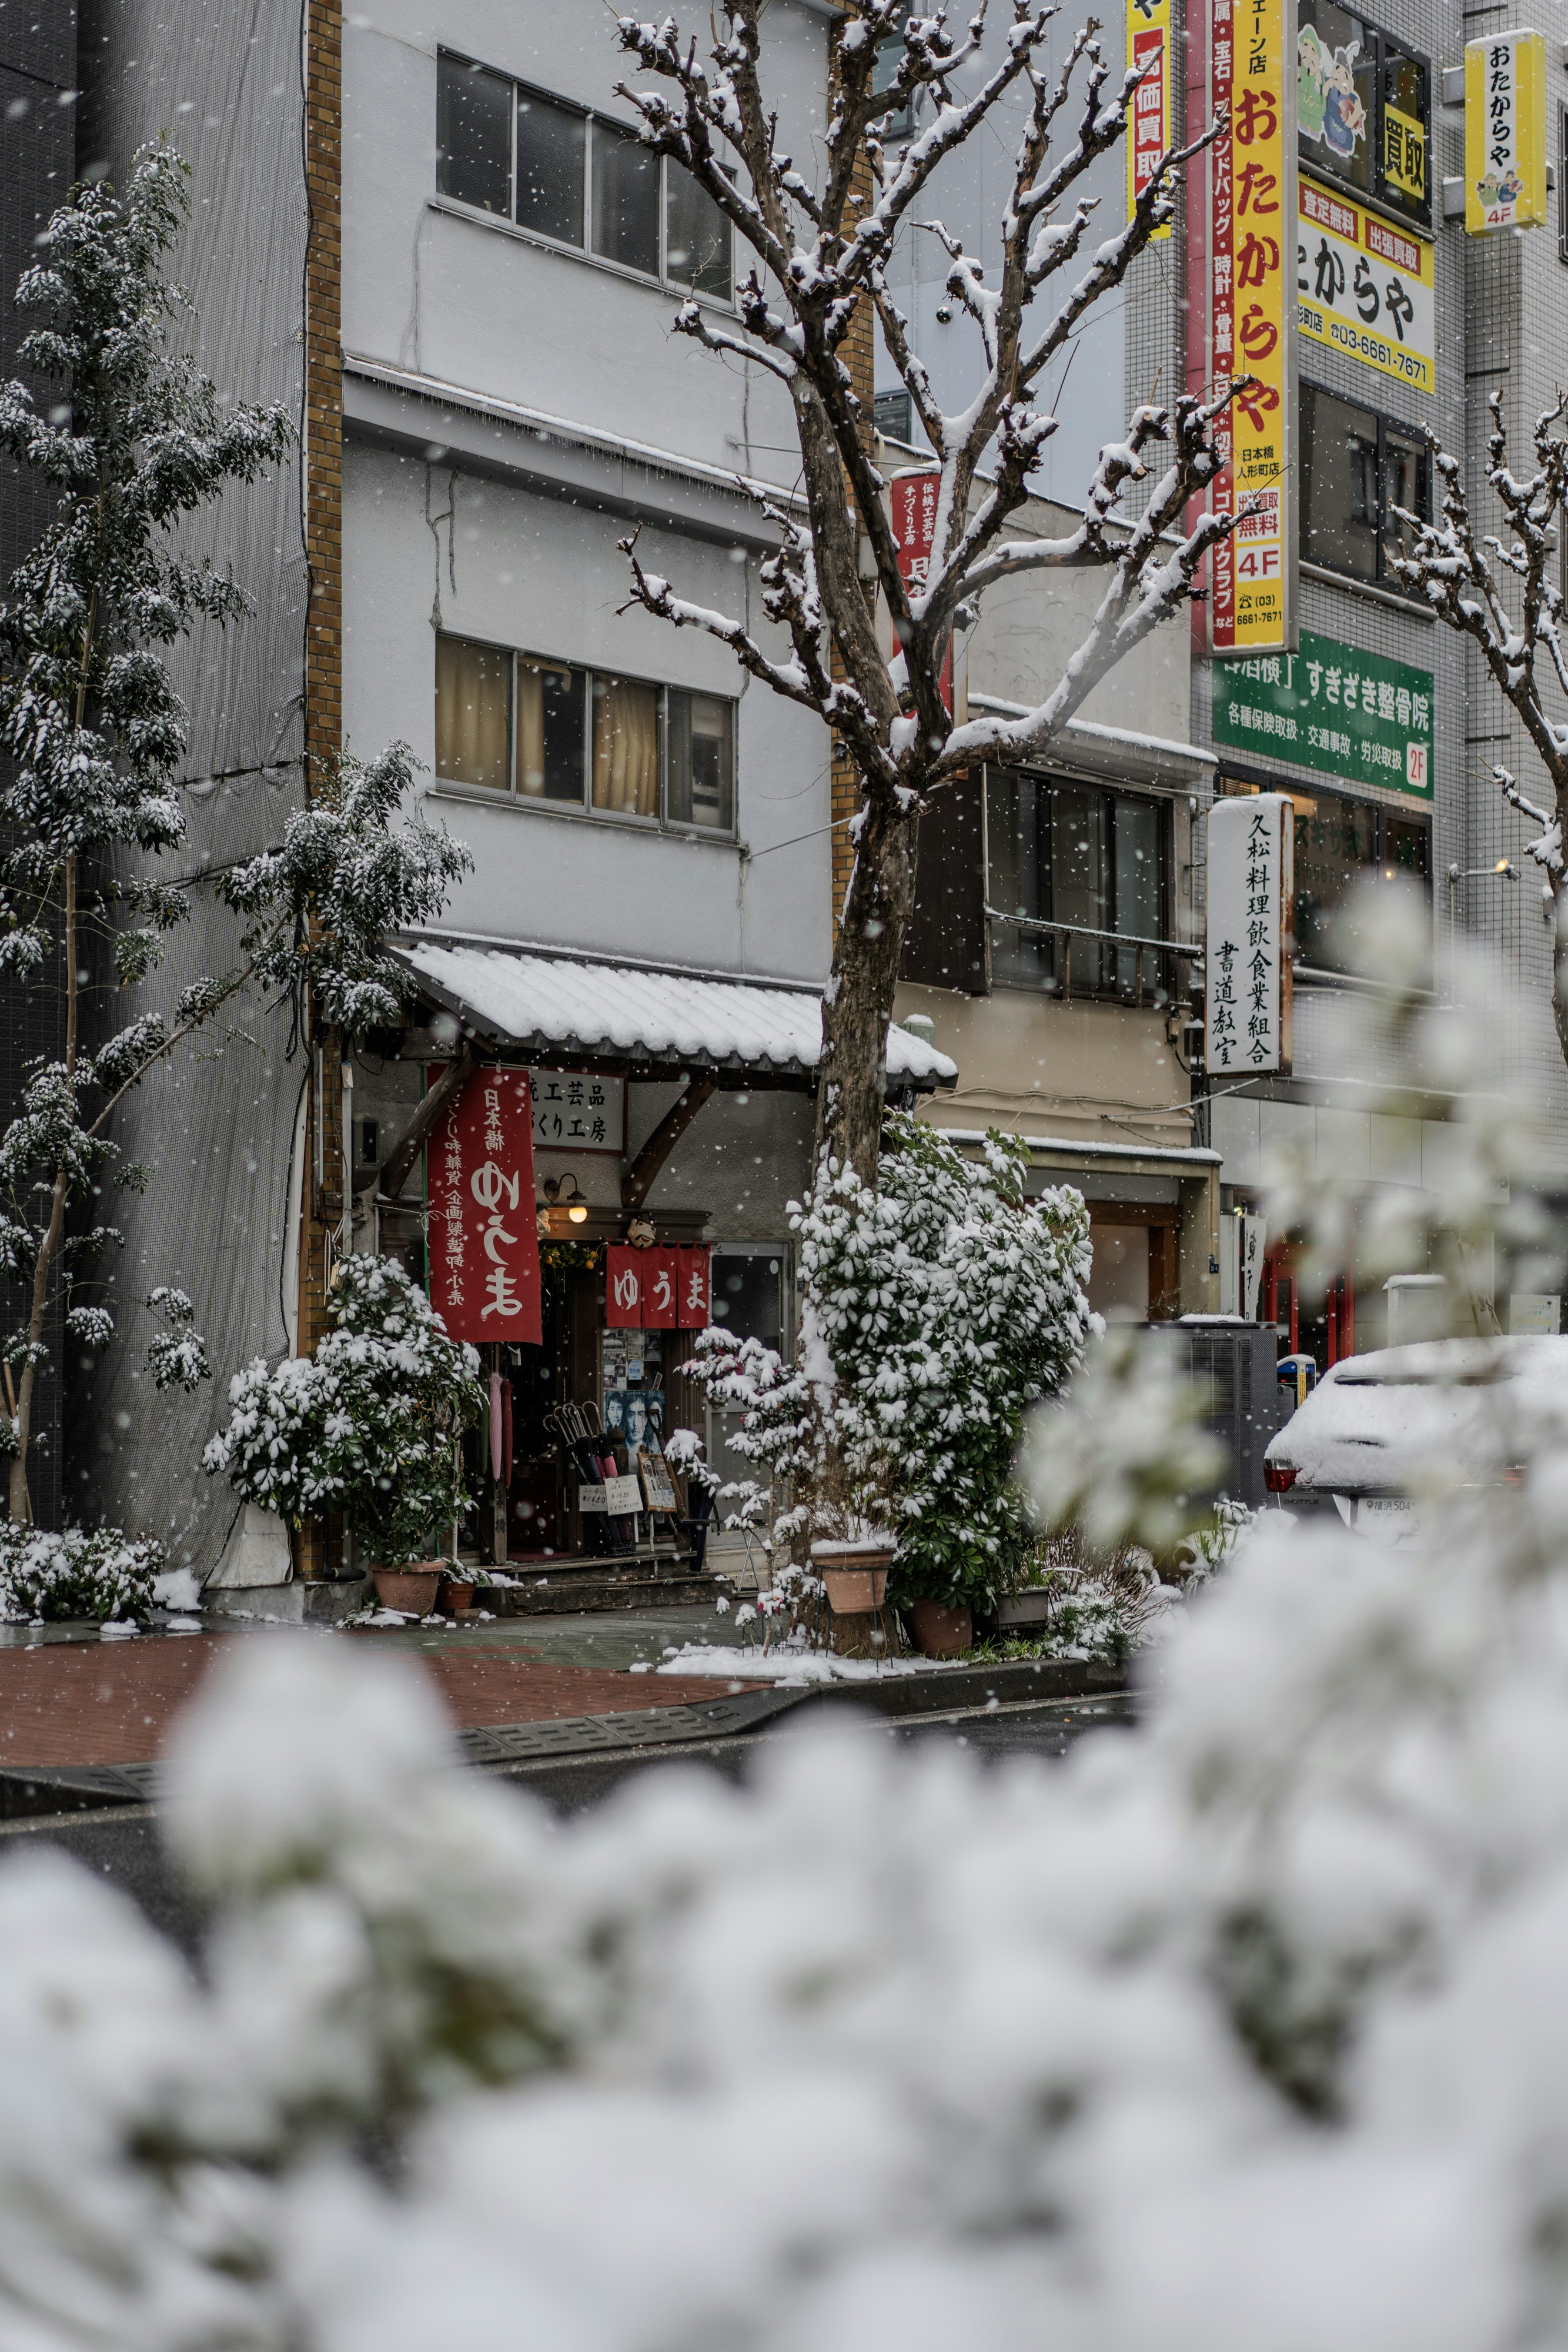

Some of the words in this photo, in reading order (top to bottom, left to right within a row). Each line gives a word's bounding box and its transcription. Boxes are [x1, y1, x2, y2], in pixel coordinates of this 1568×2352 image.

[1136, 48, 1161, 178] 高価買取
[1490, 46, 1510, 167] おたからや
[1386, 116, 1423, 191] 買取
[1304, 190, 1355, 238] 査定無料
[1487, 208, 1511, 223] 4F
[1235, 89, 1279, 433] おたからや
[1370, 225, 1417, 271] 出張買取
[1339, 326, 1427, 383] 03-6661-7671
[1237, 462, 1280, 480] 人形町店
[1243, 446, 1274, 462] 日本橋
[904, 485, 916, 545] 手づくり工房
[922, 483, 934, 541] 伝統工芸品
[1239, 513, 1279, 537] 無料
[1238, 550, 1279, 577] 4F
[1237, 611, 1282, 626] 6661-7671
[1255, 594, 1275, 607] (03)
[1306, 660, 1429, 732] すぎざき整骨院
[1411, 749, 1424, 780] 2F
[1246, 814, 1272, 1064] 久松料理飲食業組合
[1212, 941, 1239, 1065] 書道教室
[614, 1269, 706, 1310] ゆうま
